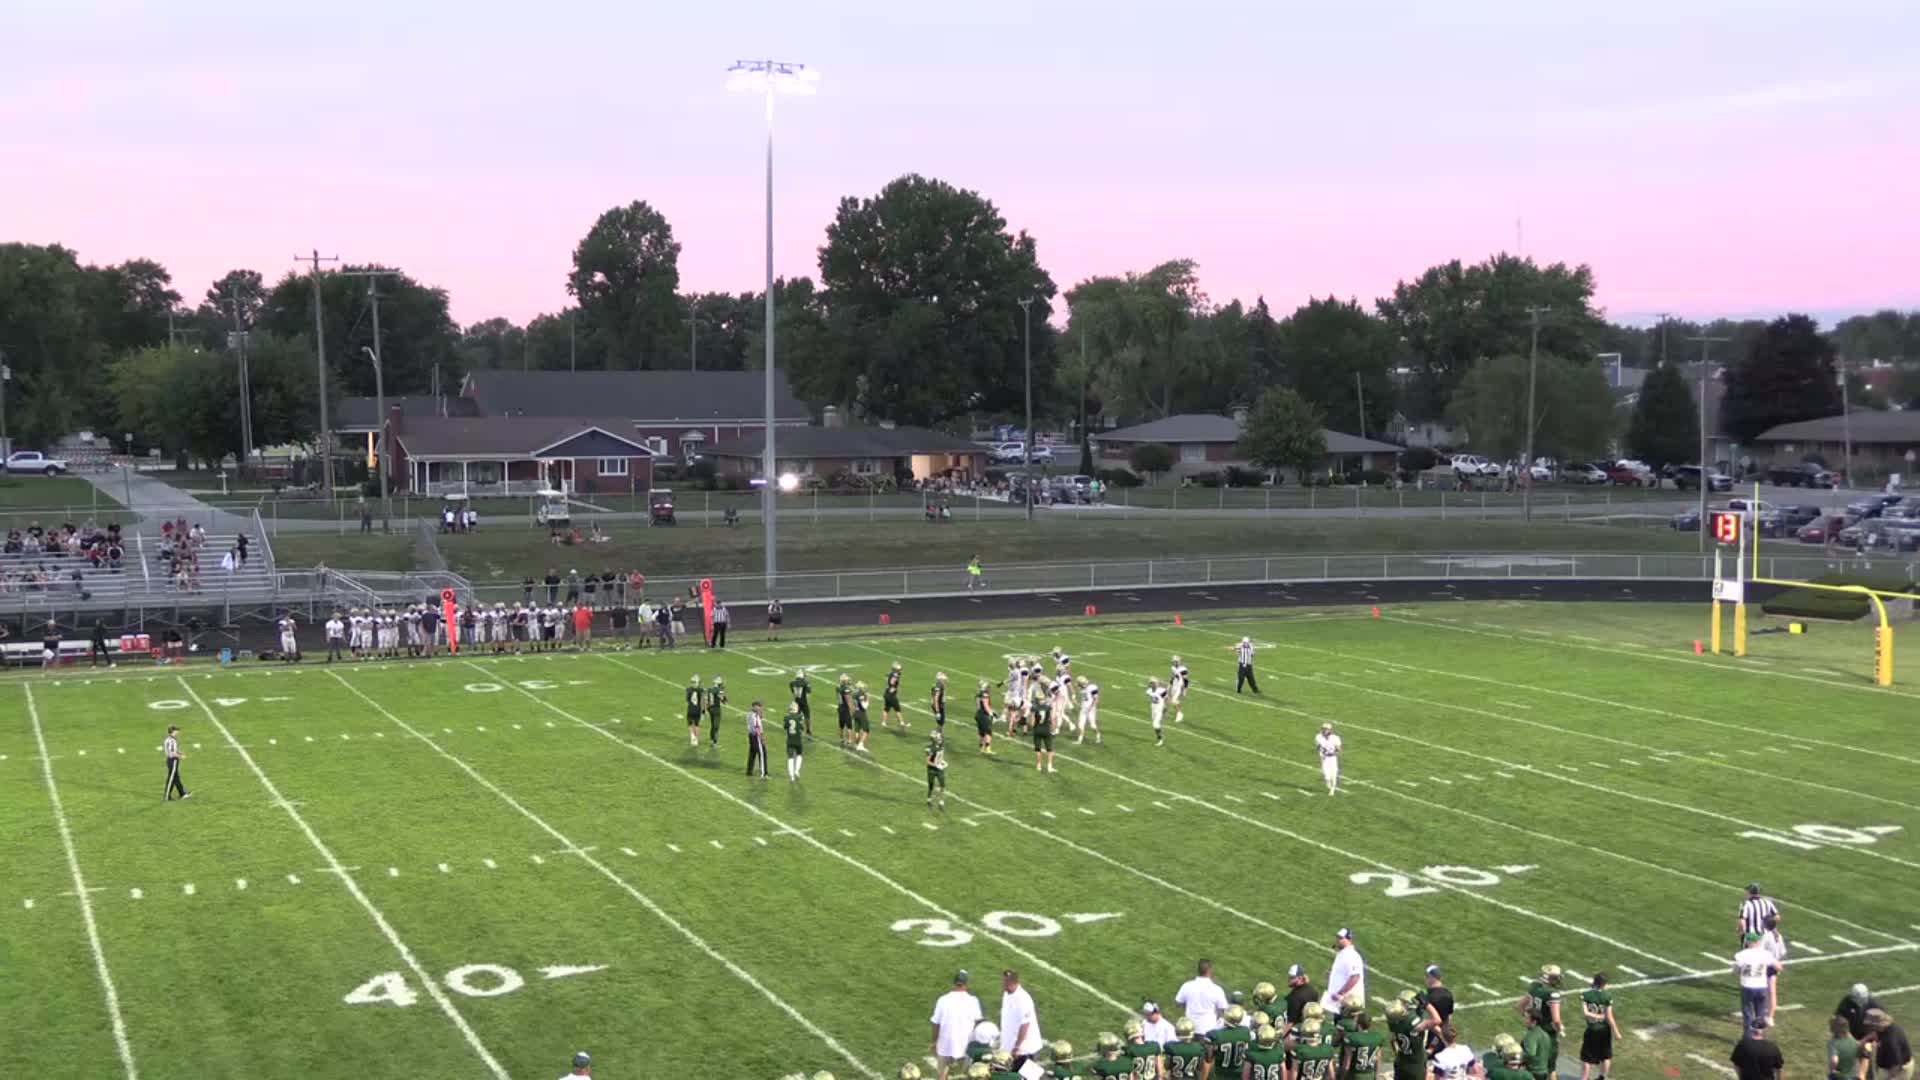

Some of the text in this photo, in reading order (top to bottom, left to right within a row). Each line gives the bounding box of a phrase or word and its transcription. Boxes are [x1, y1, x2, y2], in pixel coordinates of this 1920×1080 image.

[1717, 513, 1737, 541] 13
[1735, 824, 1878, 850] 10
[1349, 864, 1500, 897] 20
[890, 910, 1063, 948] 30
[343, 963, 526, 1007] 40
[1172, 1055, 1198, 1078] 24
